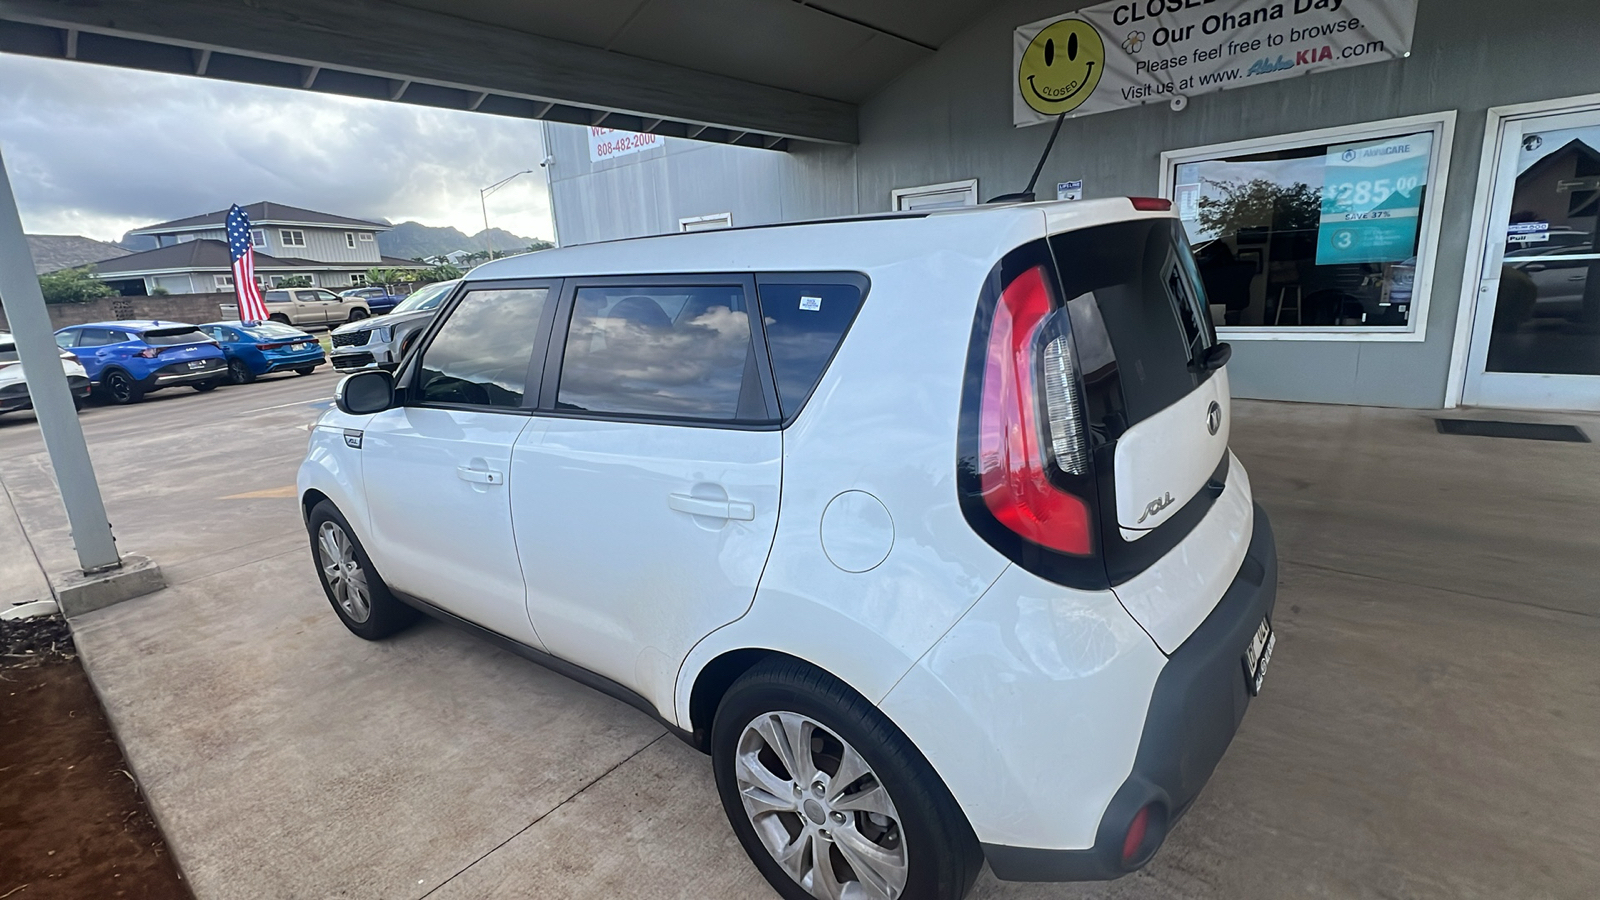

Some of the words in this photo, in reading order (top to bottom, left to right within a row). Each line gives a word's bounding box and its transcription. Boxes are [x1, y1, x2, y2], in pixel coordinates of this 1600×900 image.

[1113, 0, 1216, 26] CLOS
[1152, 25, 1195, 47] Our
[1202, 4, 1283, 35] Ohana
[1294, 0, 1343, 15] Day
[1136, 55, 1188, 75] Please
[1193, 44, 1222, 63] feel
[1228, 39, 1262, 56] free
[1267, 34, 1284, 47] to
[1290, 17, 1365, 43] browse.
[1042, 80, 1078, 97] CLOSED
[1121, 84, 1152, 100] Visit
[1156, 82, 1174, 95] us
[1179, 76, 1194, 90] at
[597, 133, 656, 156] 808-482-2000
[1344, 213, 1368, 221] SAVE
[1371, 210, 1391, 219] 37%
[1337, 231, 1352, 248] 3
